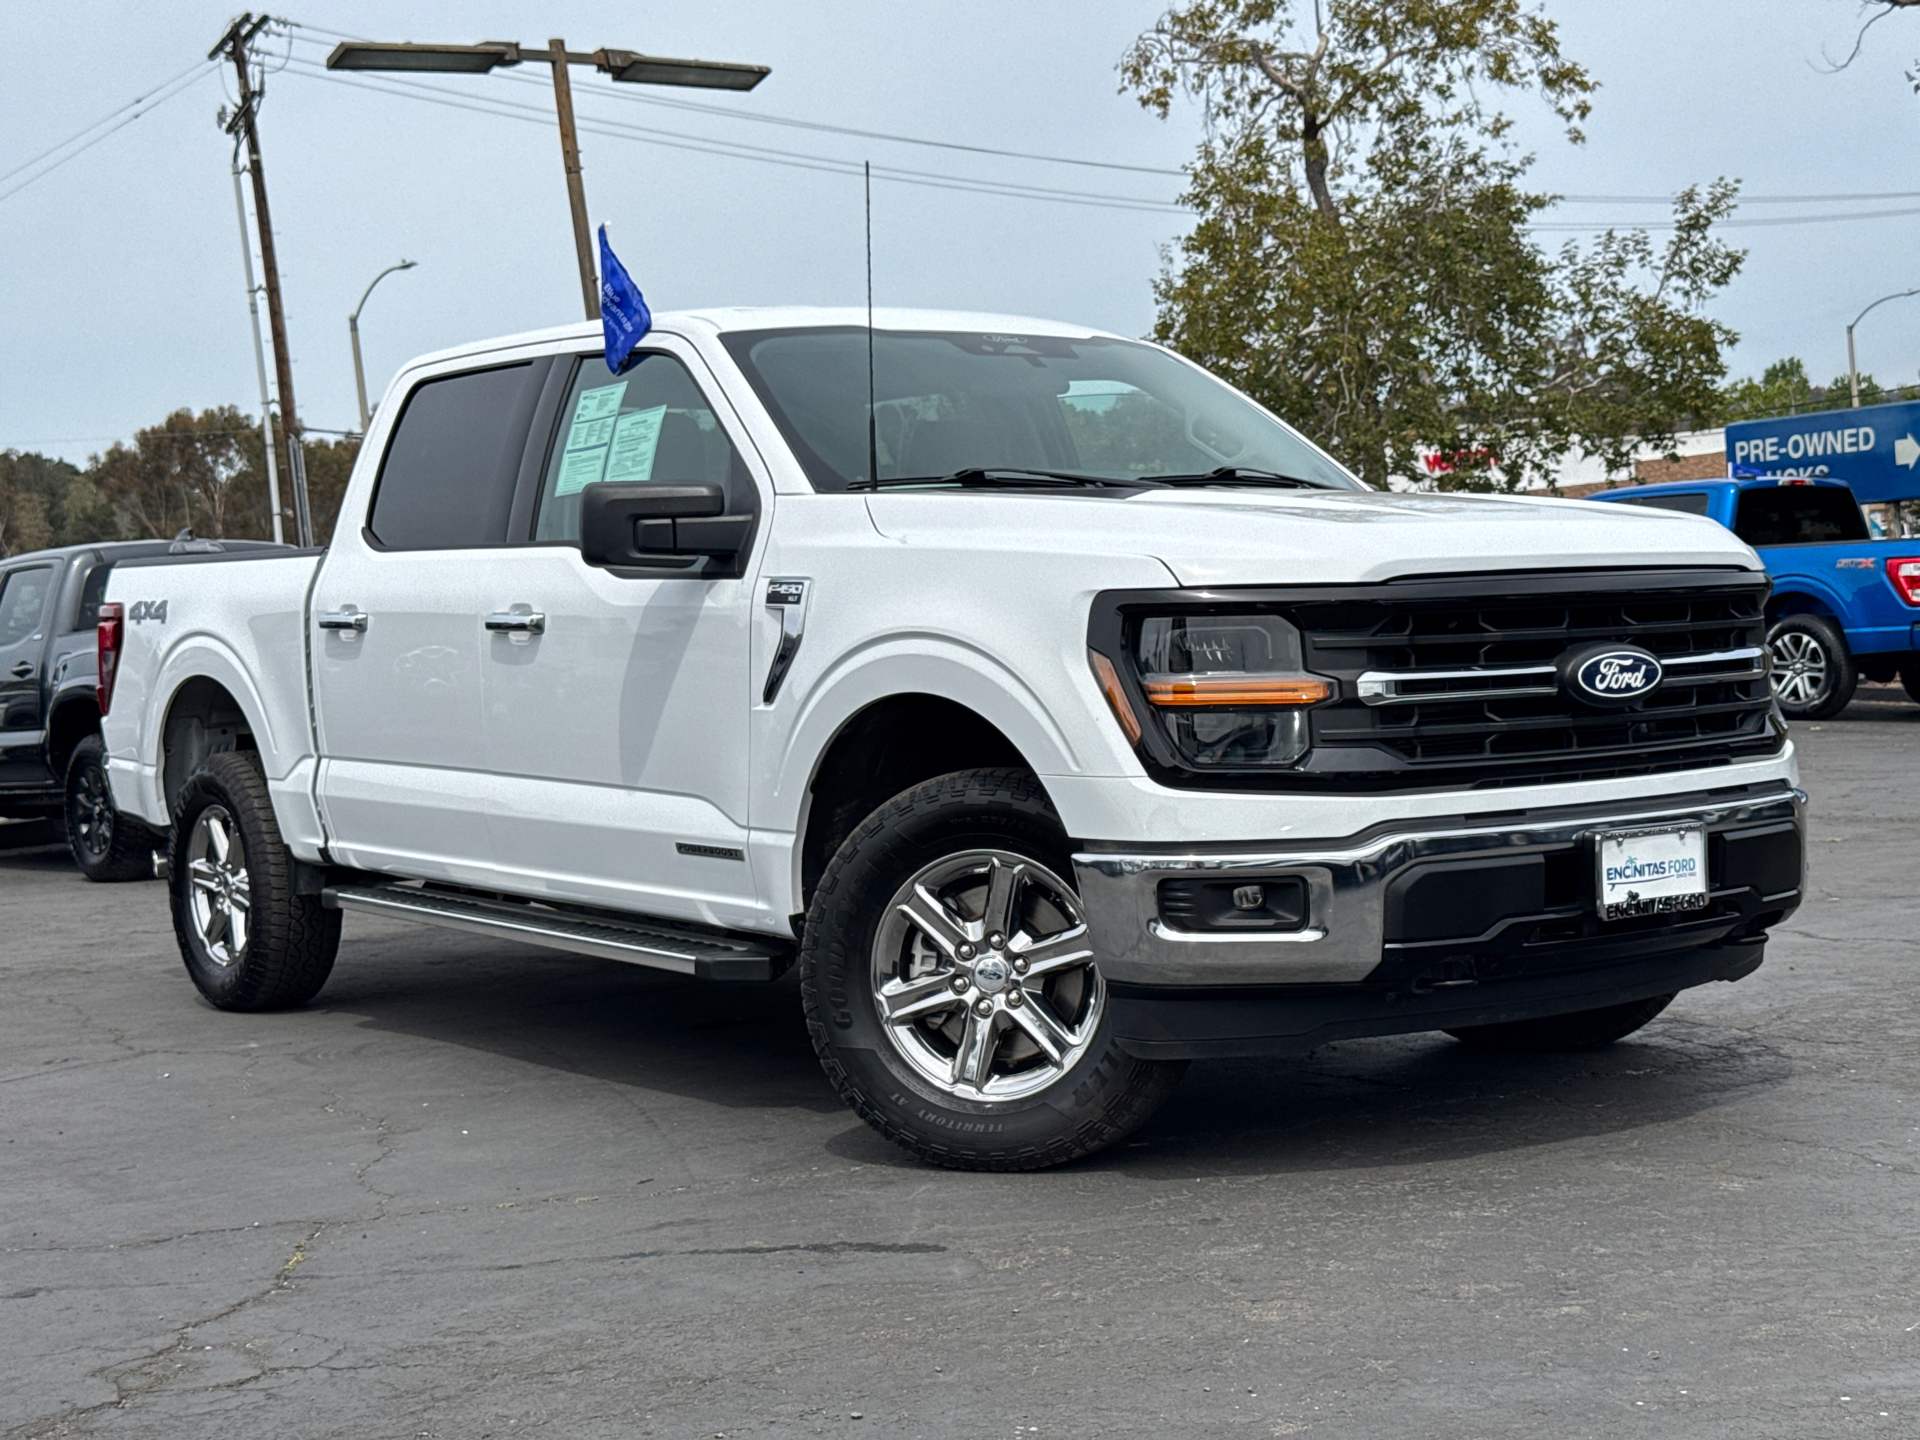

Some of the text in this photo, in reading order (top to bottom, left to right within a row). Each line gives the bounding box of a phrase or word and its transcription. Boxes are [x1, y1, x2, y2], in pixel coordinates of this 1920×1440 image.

[604, 283, 621, 303] Blue
[1735, 427, 1875, 464] PRE-OWNED
[1595, 658, 1646, 690] Ford
[678, 844, 739, 857] POWERBOOST
[1606, 858, 1696, 881] ENCINITAS FORD
[889, 1092, 909, 1106] AT
[917, 1109, 1004, 1132] TERRITORY
